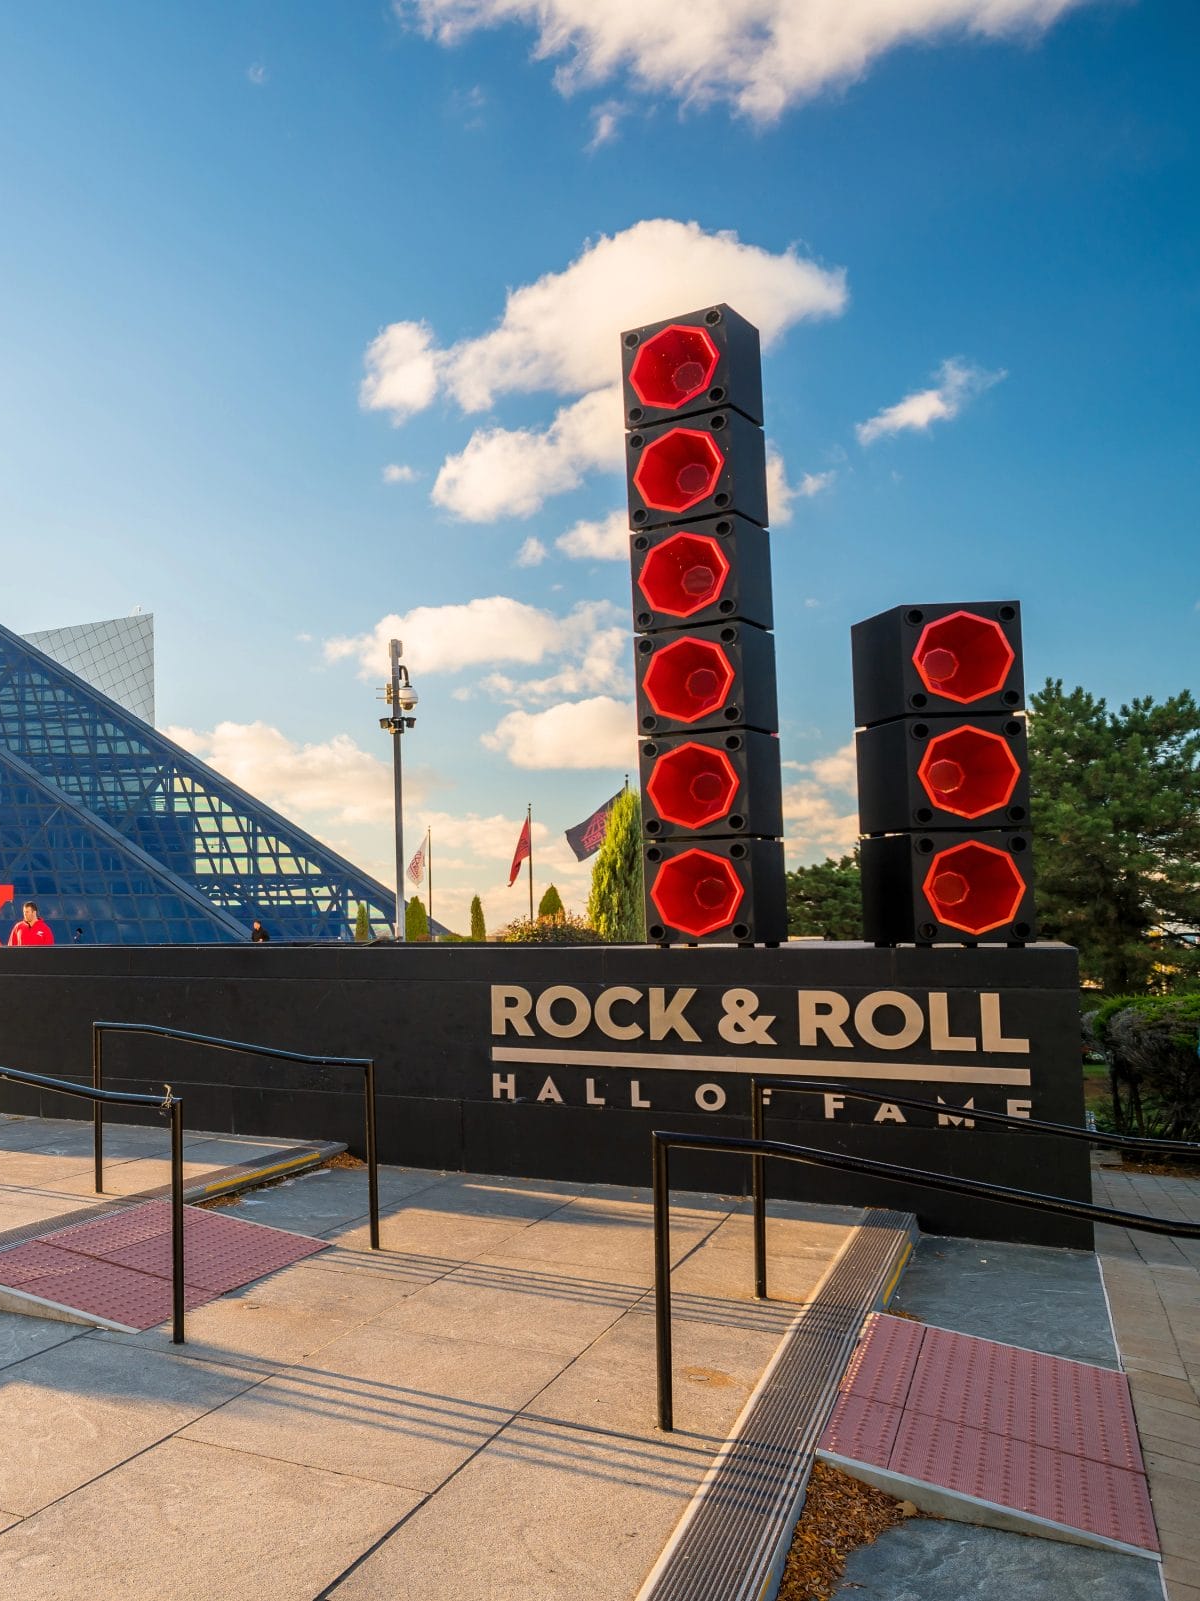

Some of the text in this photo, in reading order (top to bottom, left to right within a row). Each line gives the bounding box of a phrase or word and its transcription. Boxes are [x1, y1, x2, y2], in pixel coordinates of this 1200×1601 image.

[490, 985, 1031, 1054] ROCK & ROLL
[492, 1073, 652, 1108] HALL
[823, 1093, 1033, 1130] FAME
